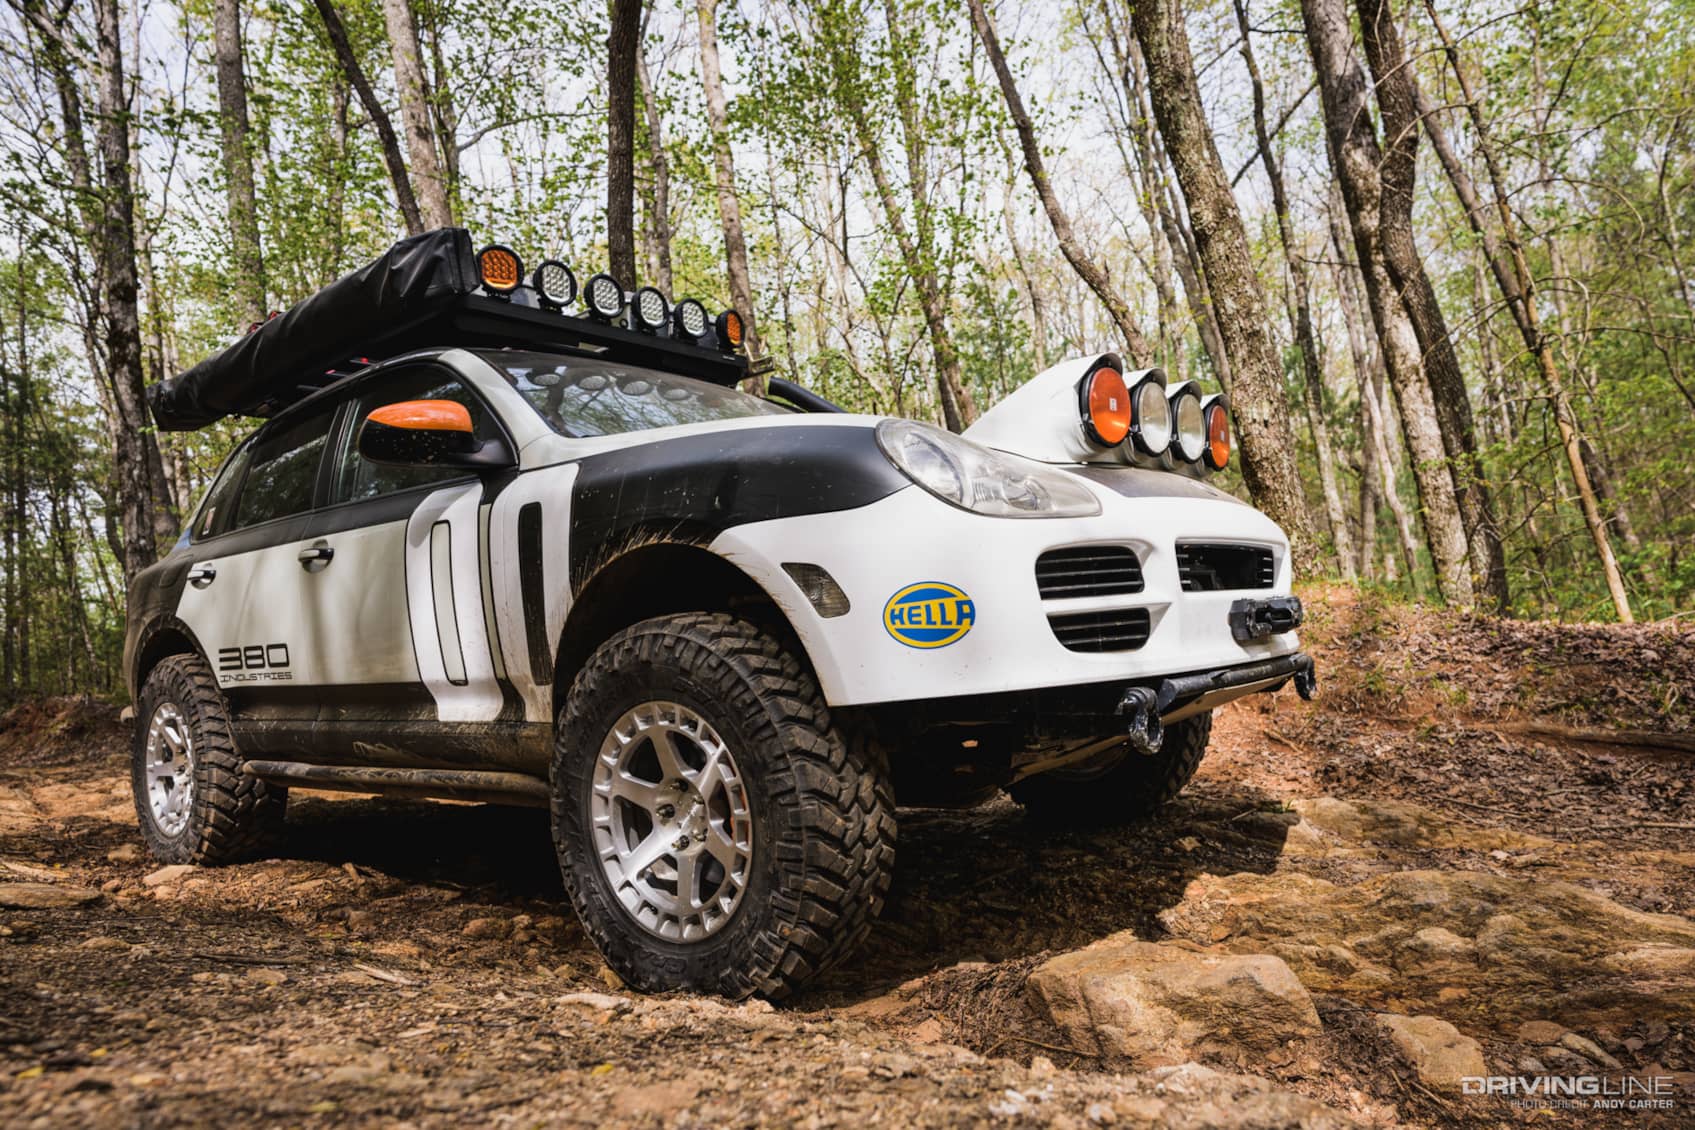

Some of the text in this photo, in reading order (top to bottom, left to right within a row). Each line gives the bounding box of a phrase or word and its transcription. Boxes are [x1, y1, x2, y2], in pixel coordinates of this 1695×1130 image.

[889, 599, 976, 626] HELLA
[218, 643, 289, 671] 380
[219, 671, 293, 683] INDUSTRIES
